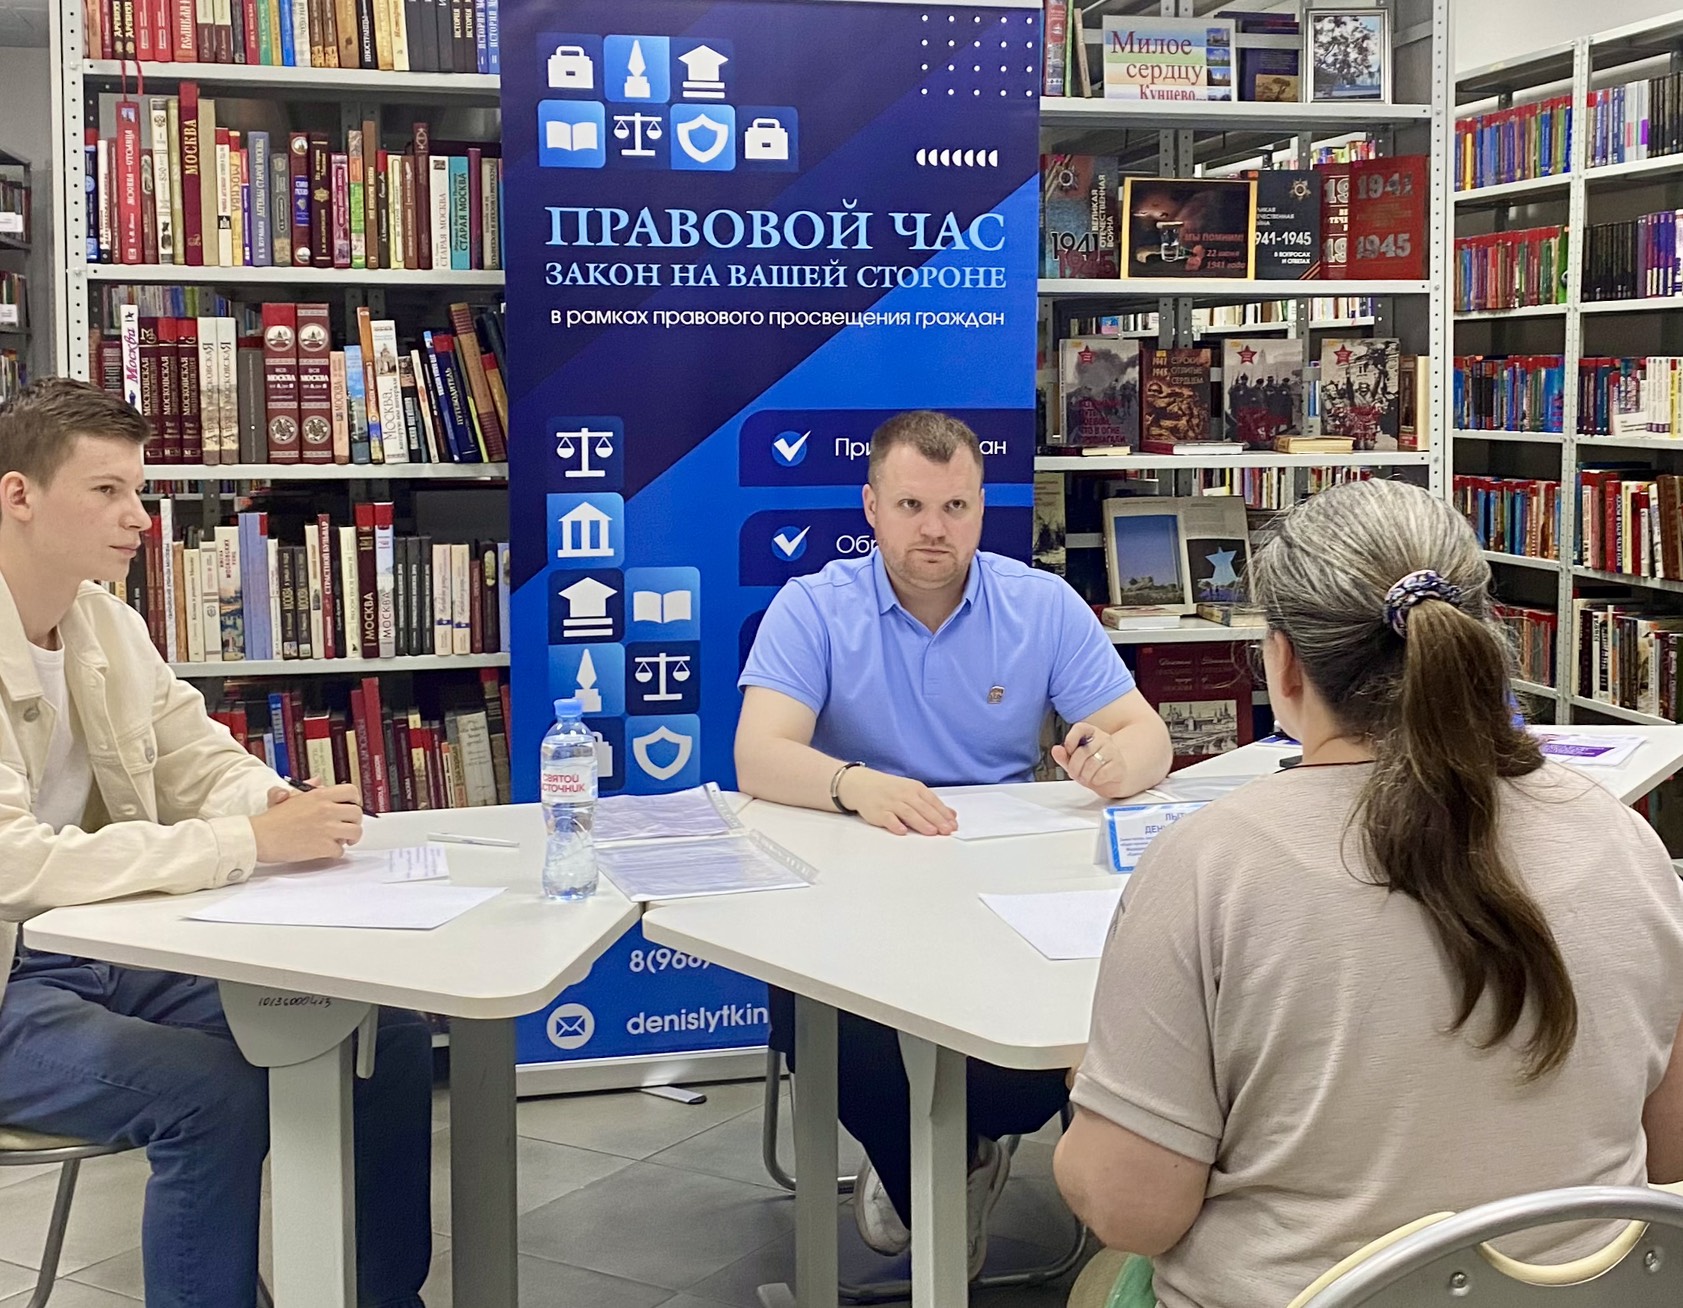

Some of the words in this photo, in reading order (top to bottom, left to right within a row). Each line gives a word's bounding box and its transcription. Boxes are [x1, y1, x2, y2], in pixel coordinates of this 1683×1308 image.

[1111, 30, 1192, 56] Милое
[1127, 63, 1204, 85] сердцу
[183, 119, 198, 175] МОСКВА
[458, 173, 467, 212] МОСКВА
[438, 193, 446, 229] МОСКВА
[545, 199, 873, 249] ПРАВОВОЙ
[888, 212, 1005, 251] ЧАС
[458, 215, 468, 251] СТАРАЯ
[1051, 232, 1099, 261] 1941
[1106, 216, 1114, 247] ВОЙНА
[1255, 232, 1311, 245] 941-1945
[439, 234, 447, 267] СТАРАЯ
[546, 262, 662, 286] ЗАКОН
[671, 264, 720, 286] НА
[728, 259, 847, 288] ВАШЕЙ
[857, 266, 1006, 289] СТОРОНЕ
[551, 312, 561, 324] в
[566, 311, 647, 329] рамках
[653, 310, 764, 329] правового
[769, 311, 911, 330] просвещения
[915, 310, 1004, 330] граждан
[123, 328, 138, 384] Москва
[142, 357, 151, 416] МОСКОВСКАЯ
[161, 357, 171, 415] МОСКОВСКАЯ
[181, 357, 190, 416] МОСКОВСКАЯ
[334, 381, 344, 411] МОСКВА
[445, 367, 464, 425] ПУТЕВОДИТЕЛЬ
[321, 521, 329, 552] БУЛЬВАР
[322, 553, 332, 594] СТРАСТНОЙ
[363, 592, 375, 640] МОСКВА
[382, 591, 392, 638] МОСКВА
[543, 784, 585, 792] СТОЧНИК
